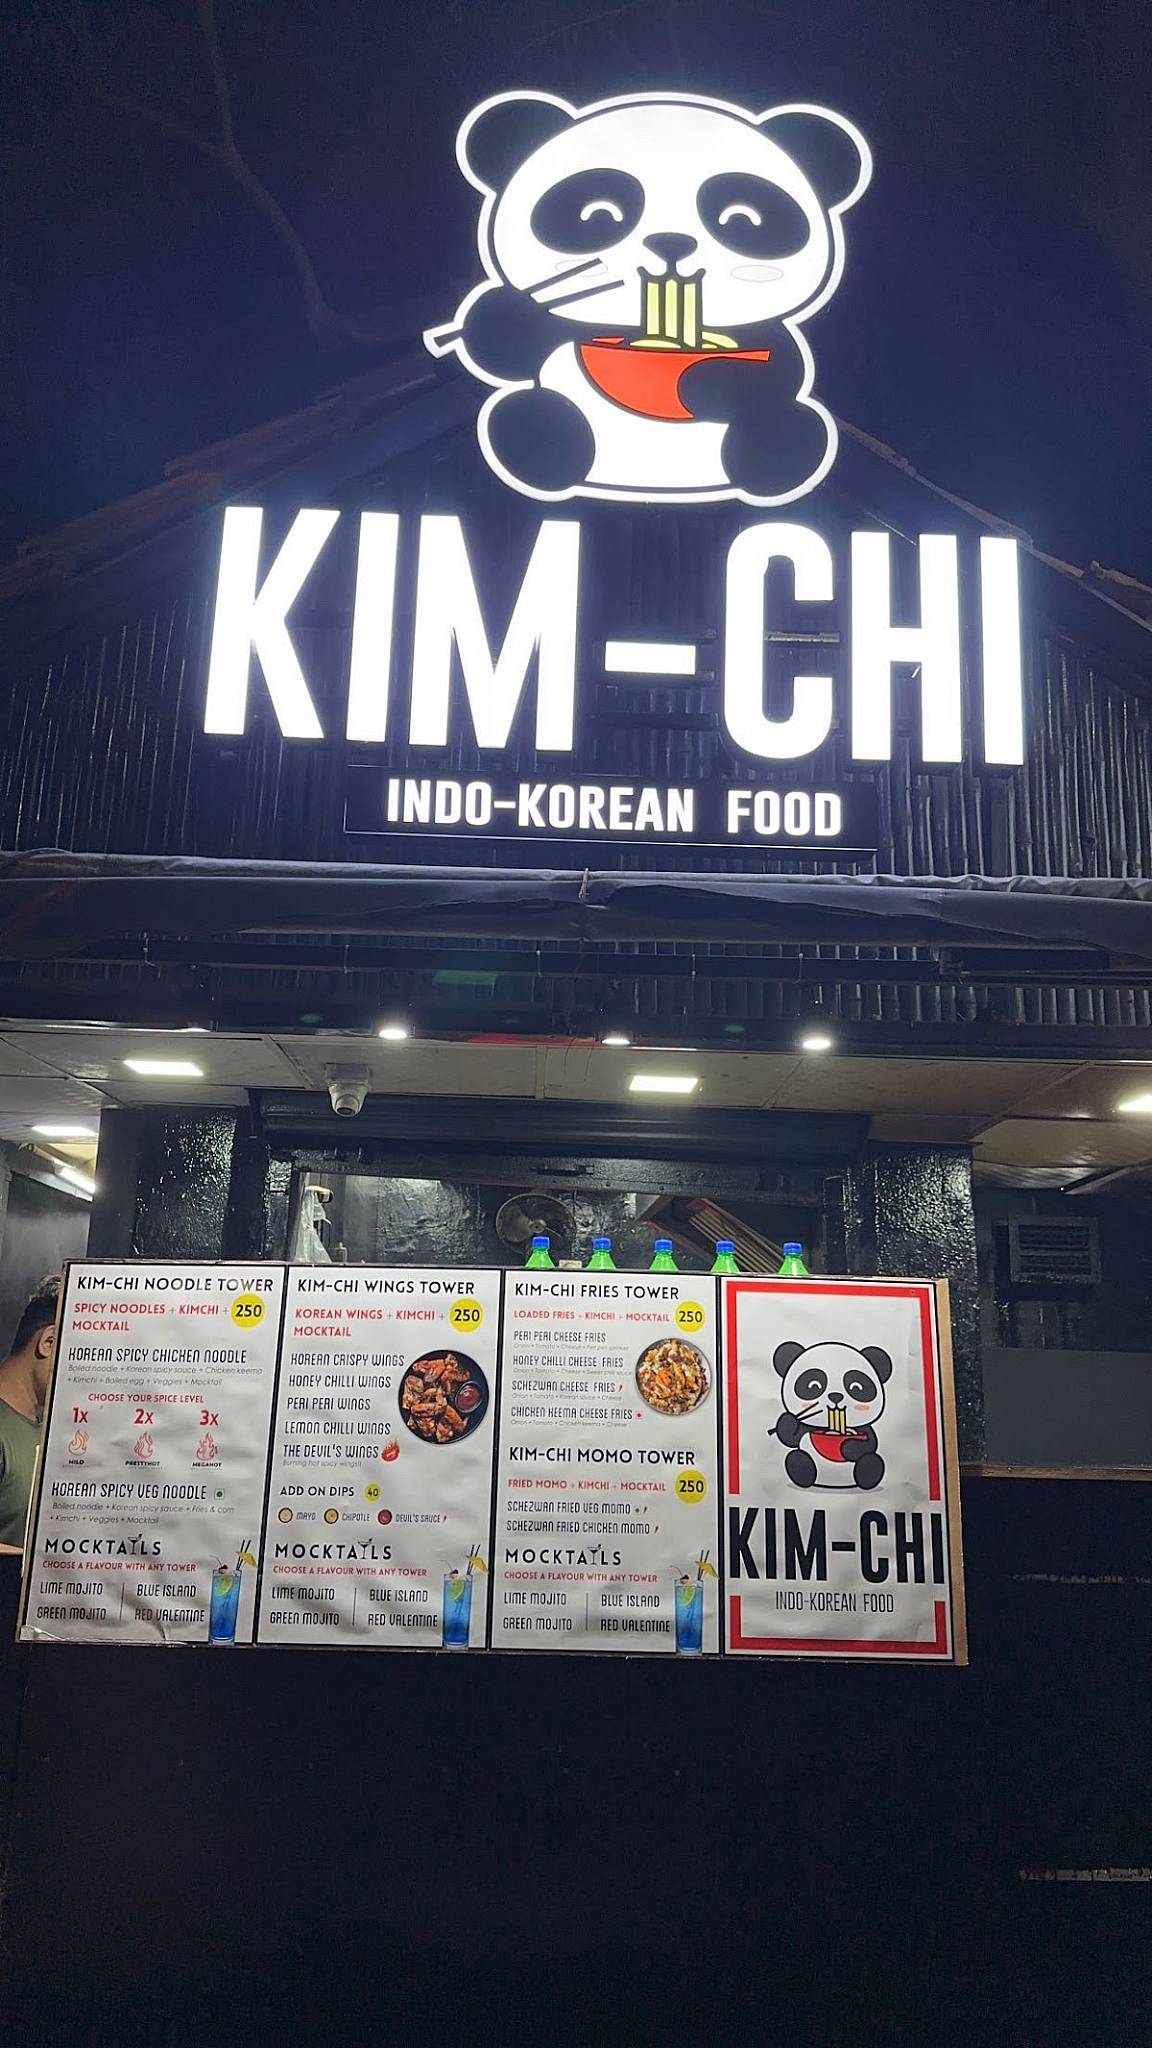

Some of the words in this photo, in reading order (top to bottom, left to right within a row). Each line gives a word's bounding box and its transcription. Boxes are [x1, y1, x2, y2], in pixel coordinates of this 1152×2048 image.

[203, 506, 1024, 766] KIM-CHI
[386, 779, 694, 834] INDO-KOREAN
[728, 788, 842, 838] FOOD
[78, 1277, 138, 1290] KIM-CHI
[145, 1278, 212, 1291] NOODLE
[218, 1279, 273, 1292] TOWER
[298, 1279, 358, 1293] KIM-CHI
[364, 1281, 414, 1294] WINGS
[420, 1282, 475, 1294] TOWER
[515, 1283, 574, 1297] KIM-CHI
[581, 1285, 618, 1298] FRIES
[625, 1286, 679, 1299] TOWER
[75, 1303, 105, 1313] SPICY
[110, 1304, 165, 1314] NOODLES
[179, 1305, 218, 1315] KIMCHI
[235, 1305, 262, 1317] 250
[296, 1309, 342, 1319] KOREAN
[347, 1309, 383, 1320] WINGS
[396, 1310, 435, 1320] KIMCHI
[454, 1309, 480, 1321] 250
[514, 1310, 550, 1319] LOADED
[553, 1311, 575, 1319] FRIES
[585, 1312, 615, 1320] KIMCHI
[626, 1313, 670, 1321] MOCKTAIL
[679, 1311, 703, 1323] 250
[73, 1321, 129, 1331] MOCKTAIL
[294, 1326, 351, 1337] MOCKTAIL
[514, 1331, 531, 1341] PERI
[534, 1331, 550, 1341] PERI
[554, 1332, 582, 1342] CHEESE
[585, 1333, 606, 1342] FRIES
[69, 1348, 112, 1362] KOREAN
[117, 1349, 149, 1362] SPICY
[153, 1350, 200, 1363] CHICKEN
[204, 1350, 247, 1364] NOODLE
[291, 1353, 329, 1366] KOREAN
[334, 1354, 368, 1366] CRISPY
[372, 1355, 405, 1367] WINGS
[513, 1355, 539, 1365] HONEY
[542, 1356, 565, 1366] CHILLI
[569, 1356, 597, 1367] CHEESE
[602, 1357, 623, 1368] FRIES
[289, 1375, 322, 1387] HONEY
[325, 1375, 354, 1388] CHILLI
[358, 1376, 391, 1388] WINGS
[512, 1381, 557, 1391] SCHEZWAN
[560, 1382, 588, 1392] CHEESE
[594, 1382, 615, 1393] FRIES
[89, 1394, 124, 1402] CHOOSE
[154, 1395, 177, 1403] SPICE
[287, 1398, 309, 1410] PERI
[312, 1398, 334, 1410] PERI
[337, 1398, 370, 1410] WINGS
[134, 1409, 154, 1424] 2x
[200, 1410, 218, 1426] 3x
[511, 1407, 545, 1417] CHICKEN
[548, 1408, 577, 1418] KEEMA
[580, 1408, 609, 1419] CHEESE
[611, 1409, 633, 1420] FRIES
[285, 1422, 320, 1434] LEMON
[324, 1422, 353, 1435] CHILLI
[358, 1423, 391, 1435] WINGS
[284, 1445, 300, 1457] THE
[304, 1445, 341, 1458] DEVIL'S
[345, 1446, 379, 1458] WINGS
[509, 1447, 571, 1461] KIM-CHI
[578, 1449, 632, 1463] MOMO
[638, 1450, 695, 1465] TOWER
[52, 1483, 96, 1497] KOREAN
[100, 1484, 134, 1498] SPICY
[138, 1485, 159, 1499] VEG
[163, 1485, 206, 1500] NOODLE
[280, 1486, 304, 1496] ADD
[308, 1486, 325, 1496] ON
[330, 1487, 354, 1496] DIPS
[508, 1480, 533, 1488] FRIED
[536, 1480, 567, 1489] MOMO
[578, 1482, 609, 1490] KIMCHI
[621, 1483, 666, 1491] MOCKTAIL
[680, 1480, 704, 1493] 250
[368, 1489, 379, 1497] 40
[507, 1501, 554, 1513] SCHEZWAN
[557, 1502, 580, 1513] FRIED
[583, 1502, 599, 1513] VEG
[602, 1503, 630, 1514] MOMO
[296, 1512, 316, 1520] MAYO
[342, 1513, 370, 1521] CHIPOTLE
[507, 1521, 554, 1532] SCHEZWAN
[557, 1522, 580, 1533] FRIED
[583, 1523, 618, 1533] CHICKEN
[621, 1523, 650, 1534] MOMO
[730, 1507, 945, 1584] KIM-CHI
[43, 1561, 76, 1569] CHOOSE
[86, 1562, 122, 1570] FLAVOUR
[167, 1564, 197, 1572] TOWER
[273, 1566, 306, 1574] CHOOSE
[317, 1567, 353, 1575] FLAVOUR
[399, 1569, 427, 1577] TOWER
[548, 1573, 584, 1581] FLAVOUR
[41, 1582, 62, 1594] LIME
[66, 1583, 103, 1595] MOJITO
[137, 1584, 159, 1596] BLUE
[163, 1585, 197, 1598] ISLAND
[272, 1587, 295, 1599] LIME
[298, 1588, 335, 1600] MOJITO
[370, 1589, 391, 1601] BLUE
[395, 1590, 428, 1602] ISLAND
[504, 1592, 526, 1604] LIME
[530, 1593, 567, 1605] MOJITO
[602, 1595, 622, 1607] BLUE
[627, 1596, 660, 1608] ISLAND
[776, 1591, 856, 1612] INDO-KOREAN
[864, 1593, 894, 1613] FOOD
[37, 1607, 66, 1620] GREEN
[69, 1608, 106, 1621] MOJITO
[135, 1608, 153, 1621] RED
[156, 1609, 205, 1622] VALENTINE
[270, 1612, 299, 1624] GREEN
[302, 1613, 339, 1625] MOJITO
[368, 1614, 385, 1625] RED
[390, 1614, 438, 1627] VALENTINE
[503, 1618, 532, 1630] GREEN
[535, 1619, 572, 1631] MOJITO
[601, 1620, 619, 1631] RED
[622, 1620, 670, 1632] VALENTINE
